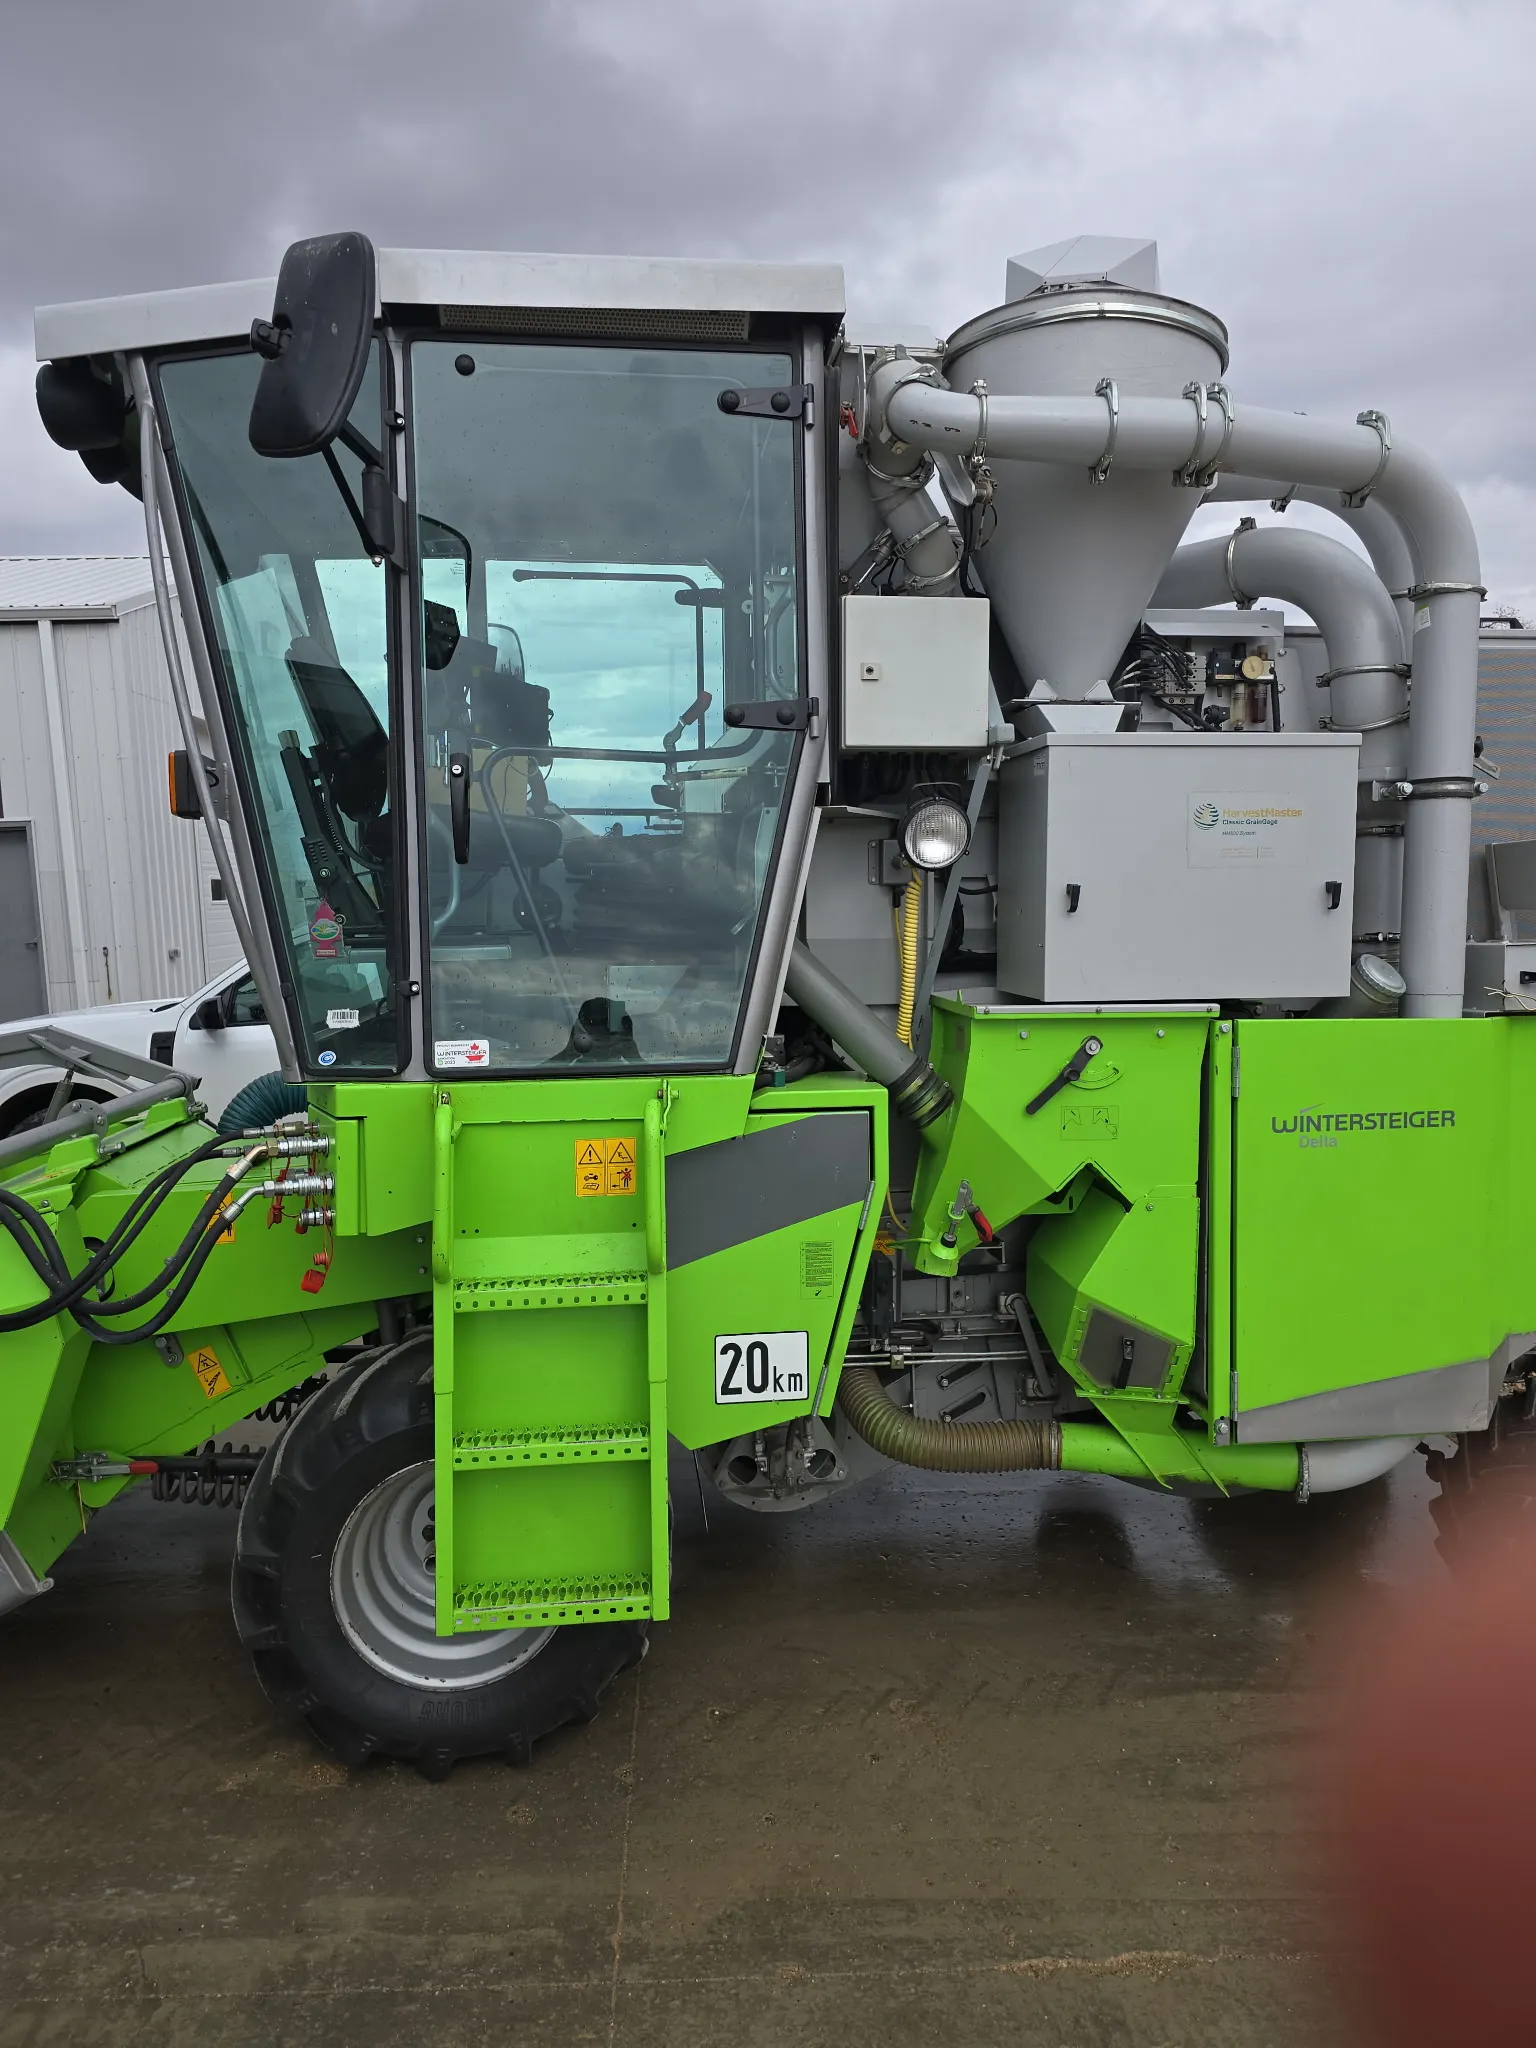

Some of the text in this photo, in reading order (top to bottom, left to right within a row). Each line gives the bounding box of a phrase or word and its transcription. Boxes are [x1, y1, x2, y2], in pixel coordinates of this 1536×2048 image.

[1222, 808, 1303, 818] HarvestMaster
[1245, 818, 1278, 826] GrainGage
[1271, 1108, 1456, 1134] WINTERSTEIGER
[1298, 1135, 1338, 1149] Delta
